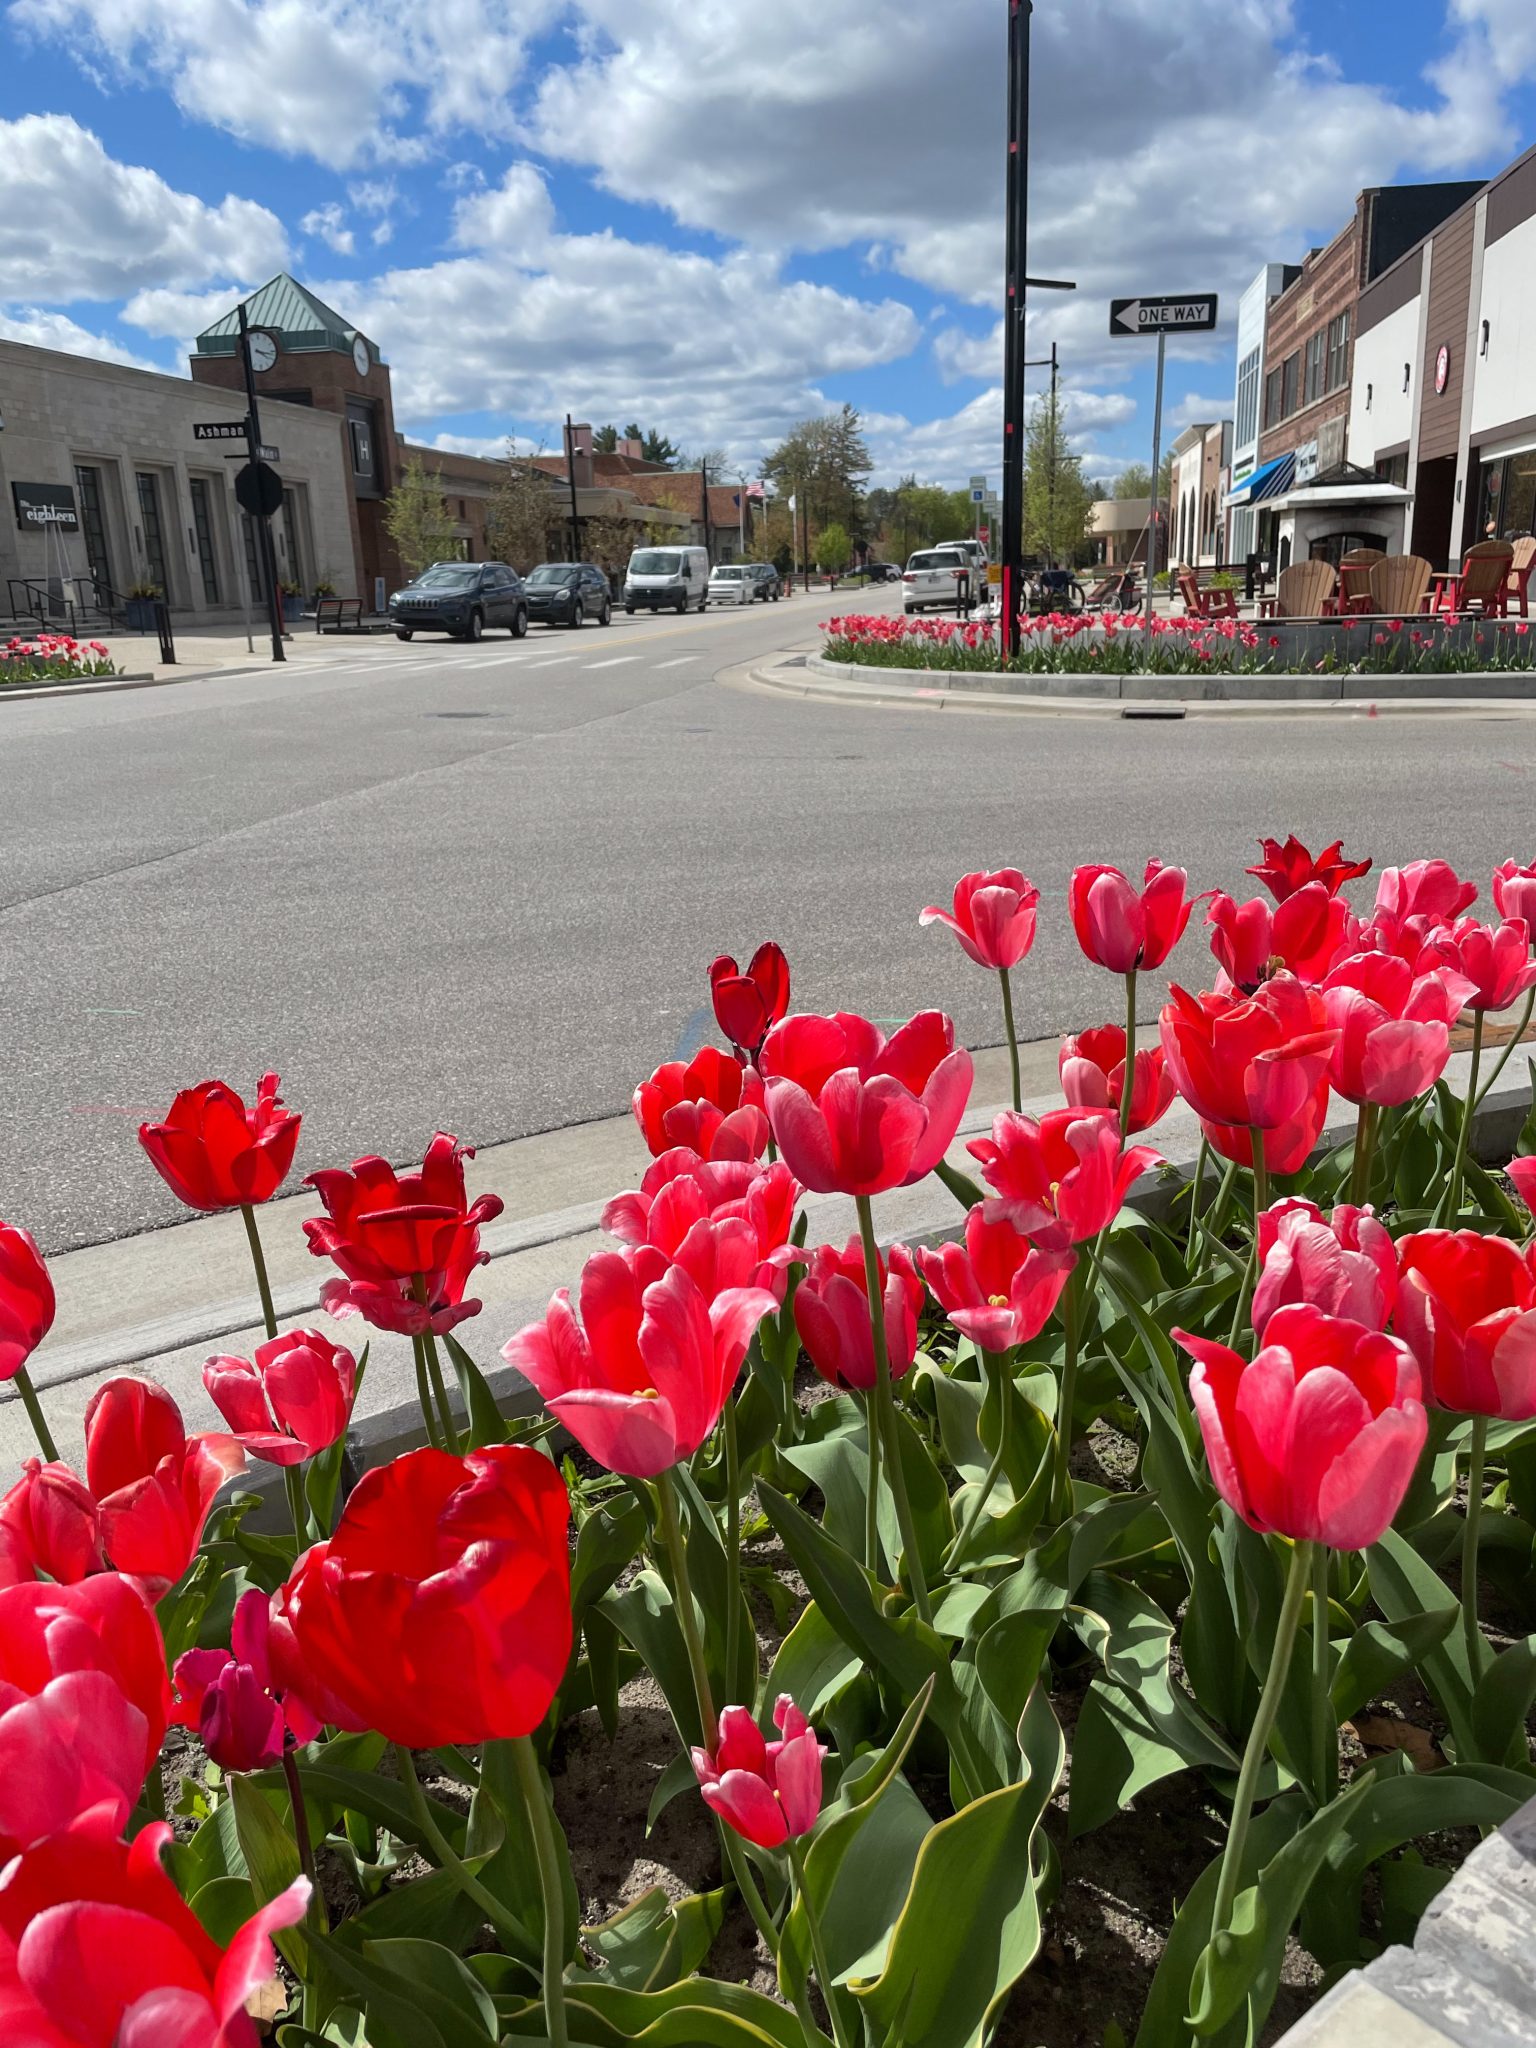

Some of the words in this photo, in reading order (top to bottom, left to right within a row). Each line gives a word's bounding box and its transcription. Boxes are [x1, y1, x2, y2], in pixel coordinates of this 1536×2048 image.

[1138, 308, 1169, 323] ONE
[1174, 305, 1205, 321] WAY
[198, 426, 244, 438] Ashman
[359, 440, 369, 460] H
[26, 503, 77, 525] eighteen
